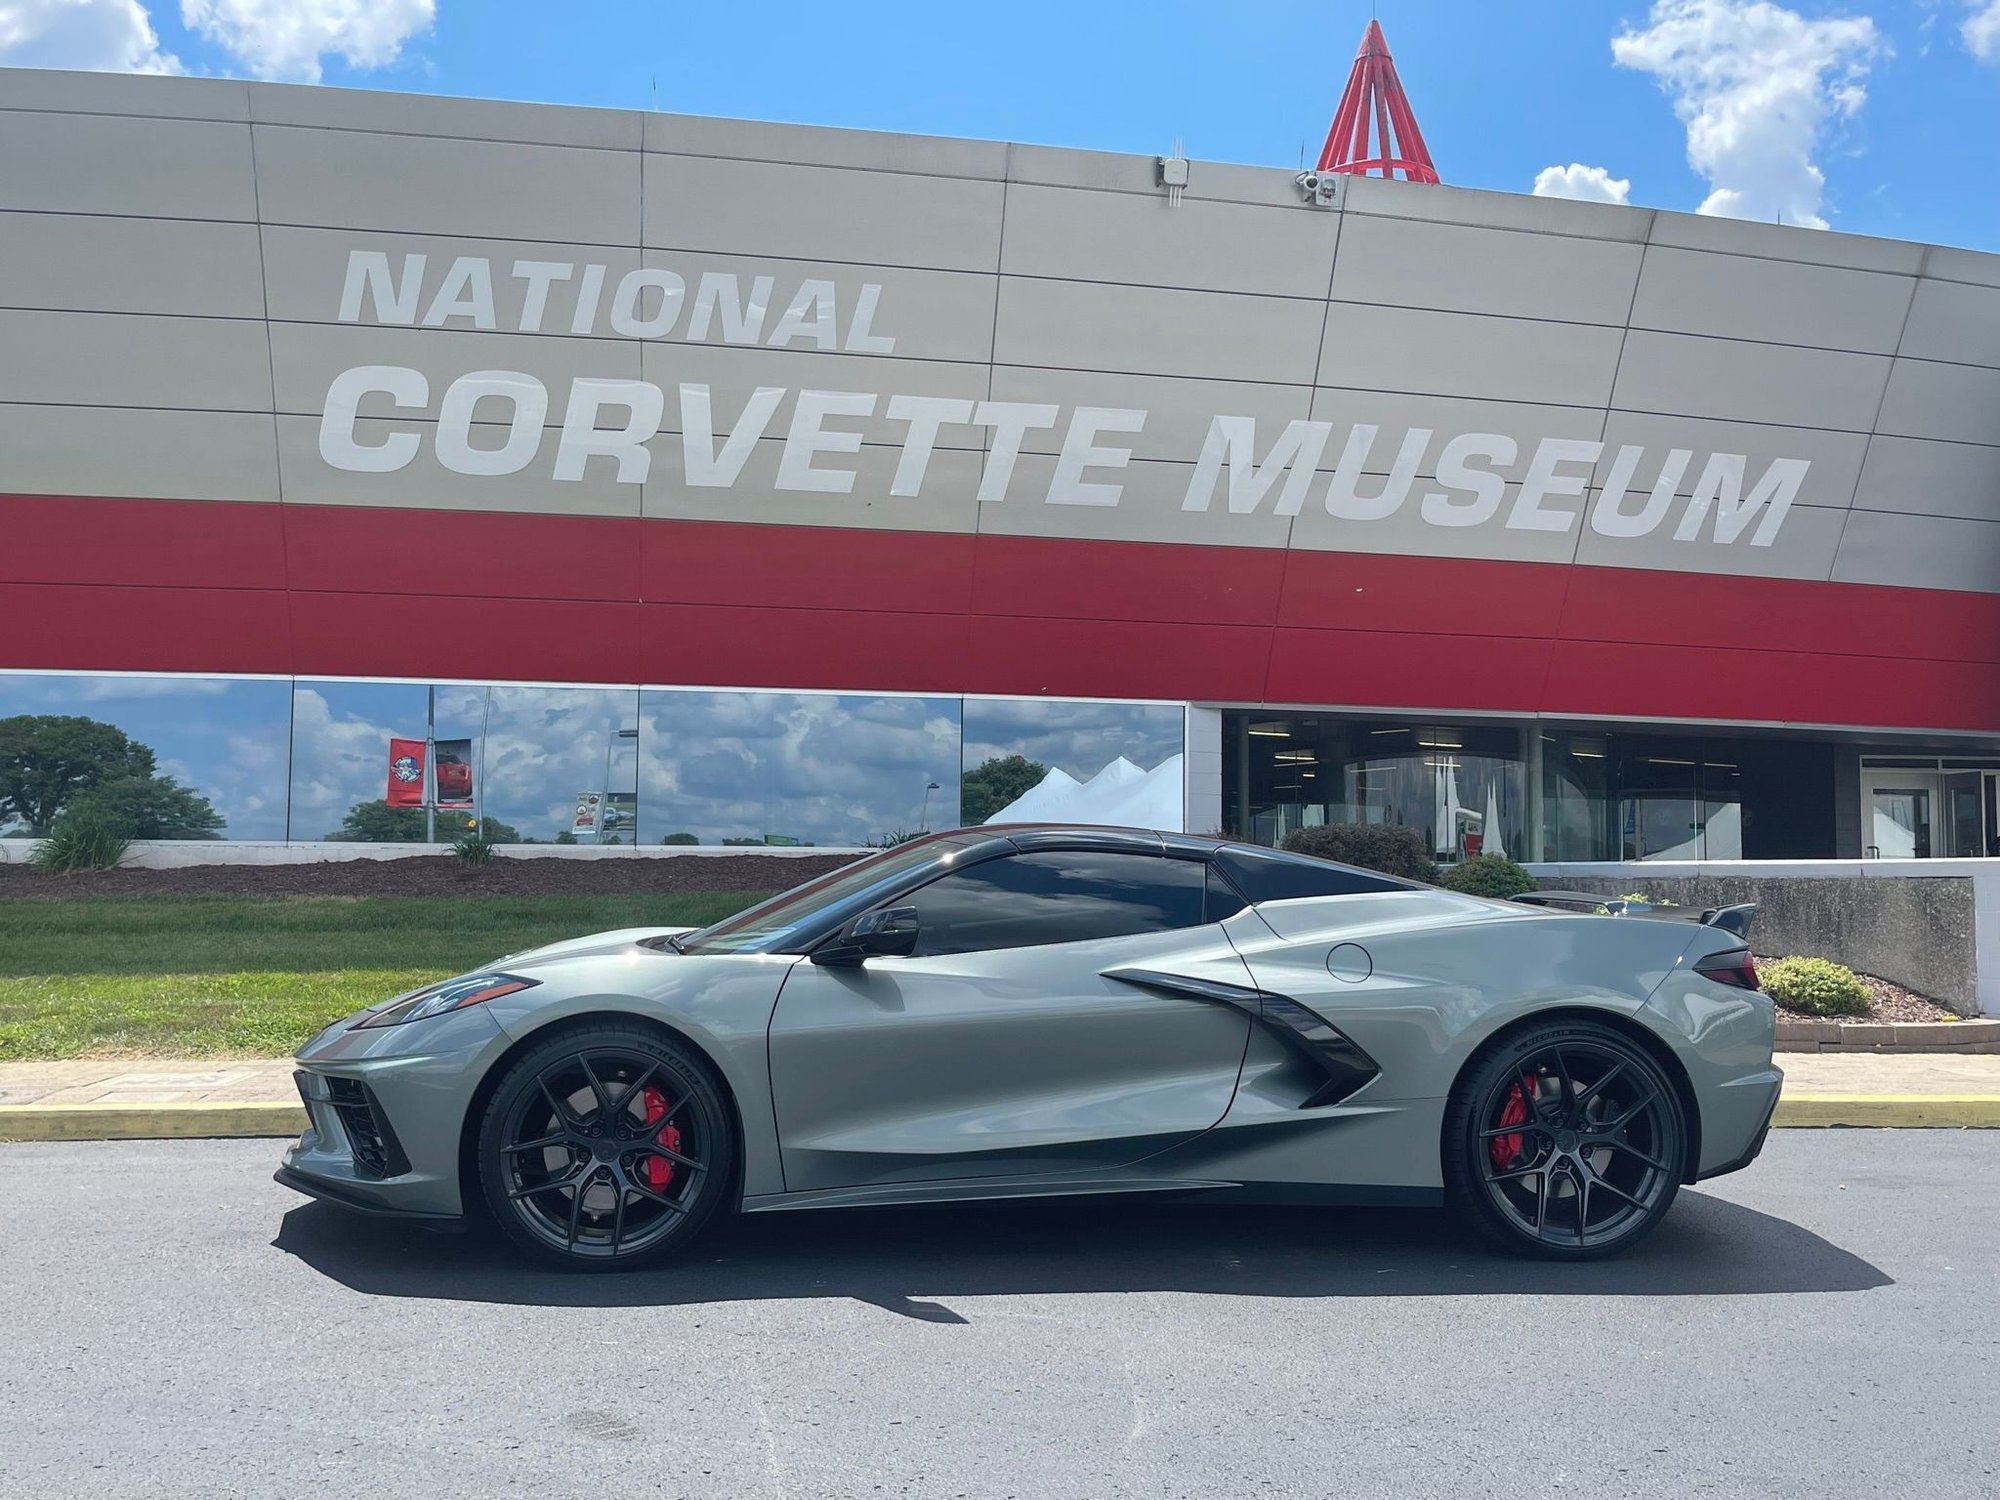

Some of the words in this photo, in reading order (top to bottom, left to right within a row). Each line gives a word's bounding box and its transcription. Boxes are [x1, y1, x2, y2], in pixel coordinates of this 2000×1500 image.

[338, 249, 897, 354] NATIONAL
[318, 365, 1147, 507] CORVETTE
[1181, 414, 1811, 547] MUSEUM
